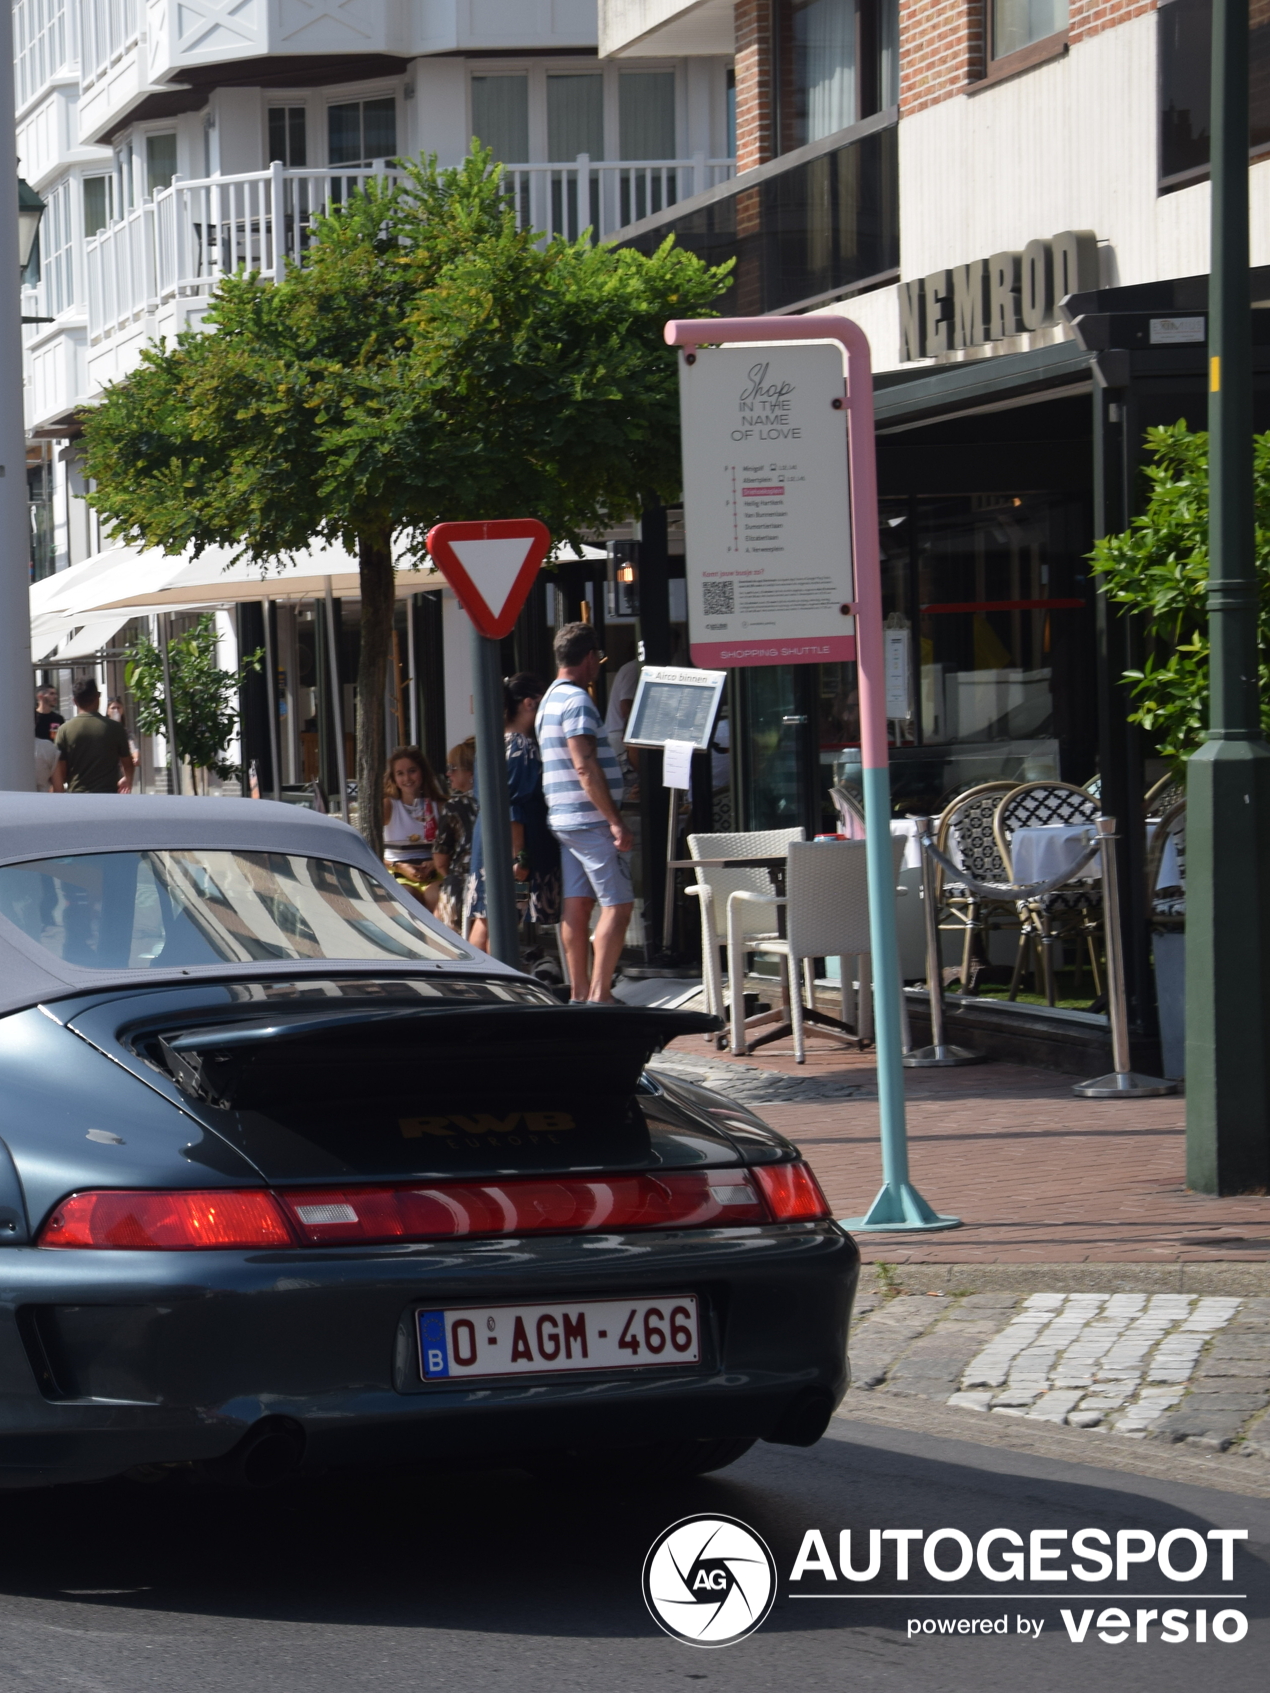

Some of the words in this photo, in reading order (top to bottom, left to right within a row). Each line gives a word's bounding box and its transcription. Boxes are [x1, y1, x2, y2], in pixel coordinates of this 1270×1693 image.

[898, 229, 1094, 363] NEMROD
[739, 362, 796, 414] Shop
[739, 401, 754, 412] IN
[759, 400, 791, 411] THE
[742, 414, 790, 426] NAME
[731, 430, 753, 441] OF
[760, 428, 802, 440] LOVE
[720, 648, 778, 659] SHOPPING
[781, 645, 830, 655] SHUTTLE
[655, 671, 677, 681] Airco
[679, 672, 708, 684] binnen
[398, 1111, 577, 1138] RWB
[446, 1134, 561, 1149] EUROPE
[428, 1350, 444, 1372] B
